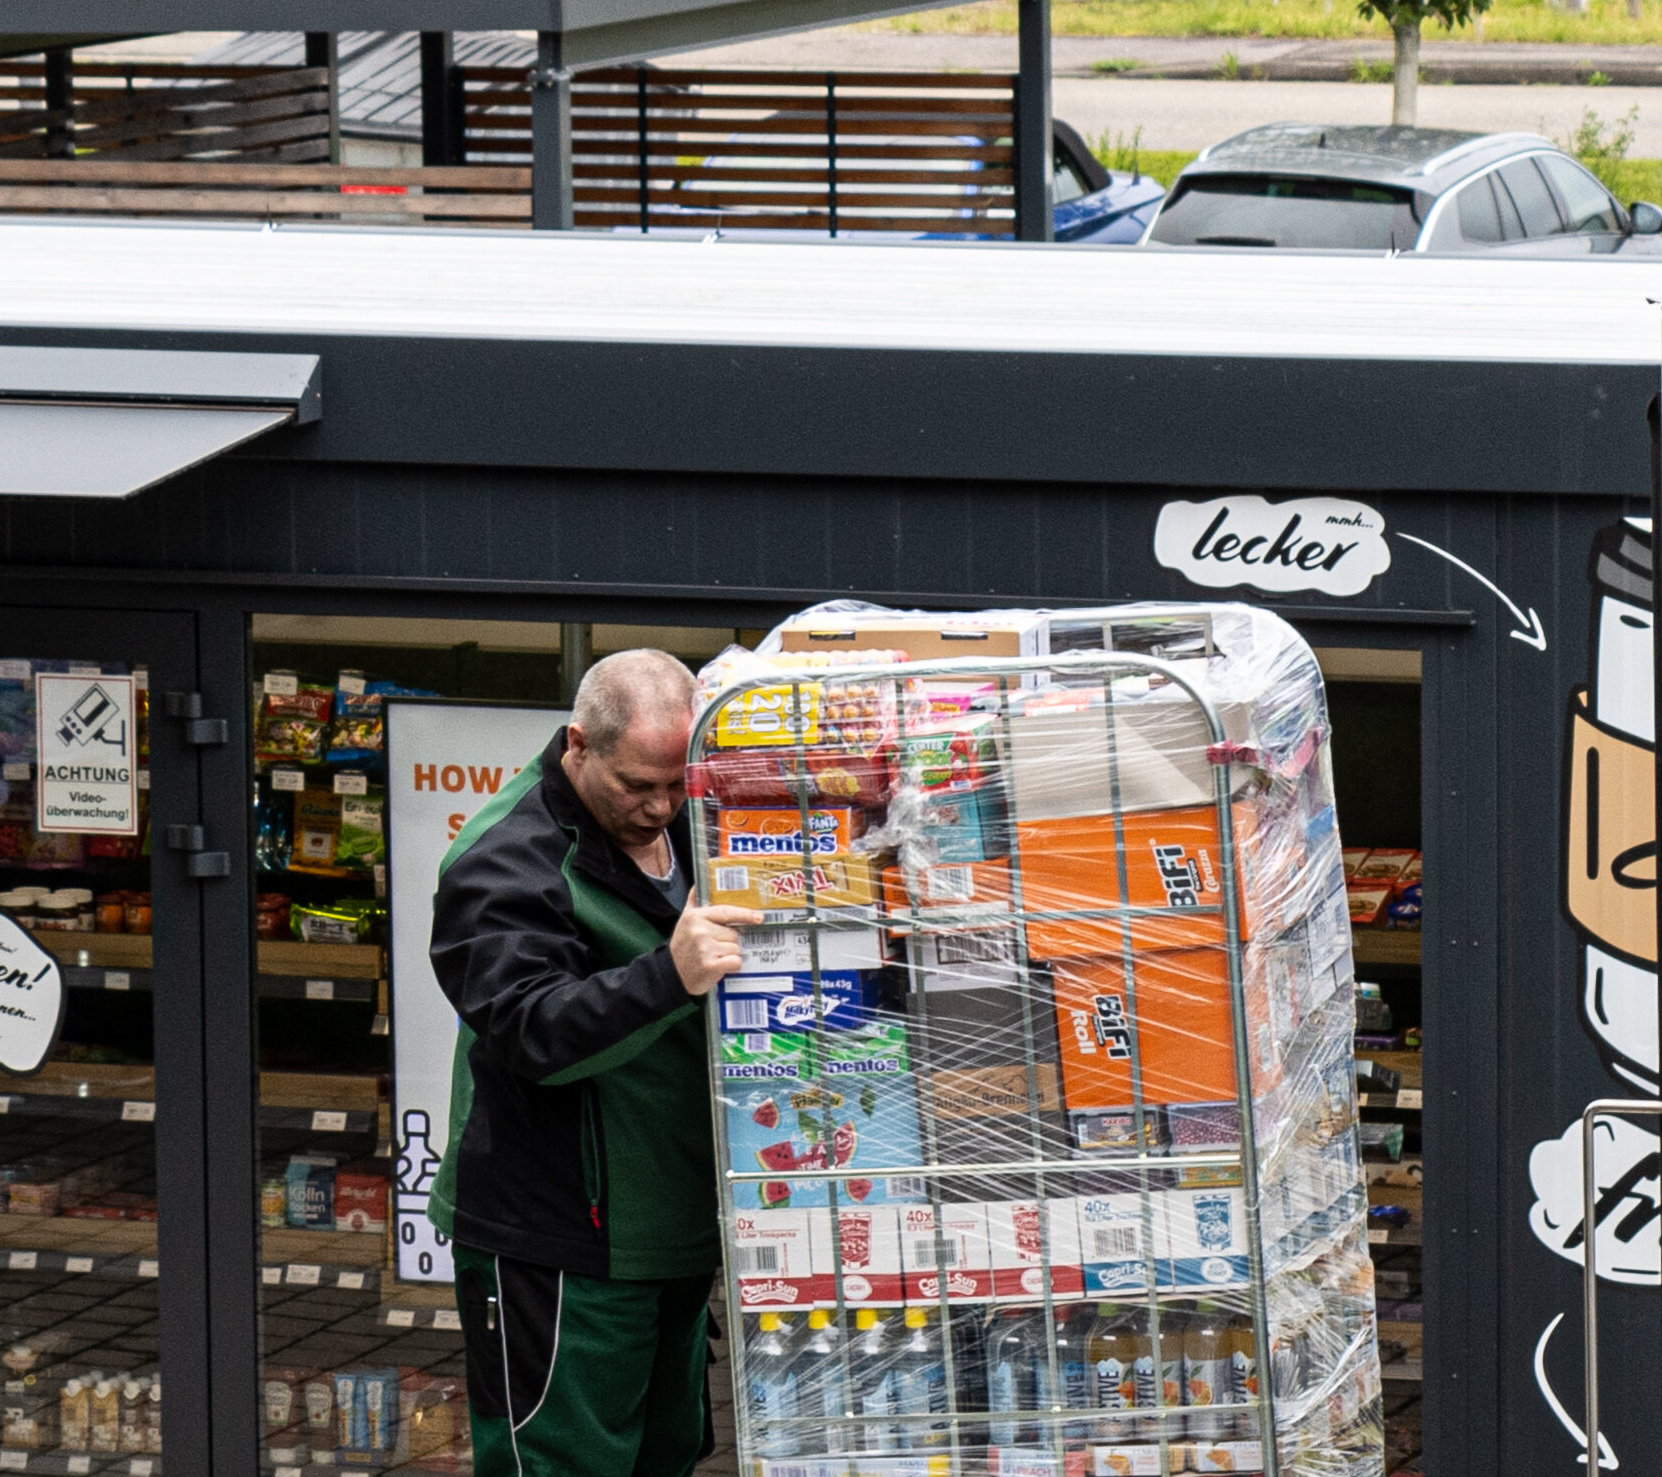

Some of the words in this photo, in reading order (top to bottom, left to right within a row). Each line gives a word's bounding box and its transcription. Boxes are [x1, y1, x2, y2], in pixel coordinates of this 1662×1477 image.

[1192, 506, 1359, 572] lecker
[45, 766, 129, 782] ACHTUNG
[413, 763, 504, 795] HOW
[69, 792, 106, 804] Video-
[46, 807, 129, 821] überwachung!
[808, 815, 839, 833] FANTA
[728, 833, 837, 854] mentos
[1071, 1009, 1097, 1055] Roll
[1093, 994, 1133, 1059] BiFi
[742, 1280, 798, 1297] Capri-Sun
